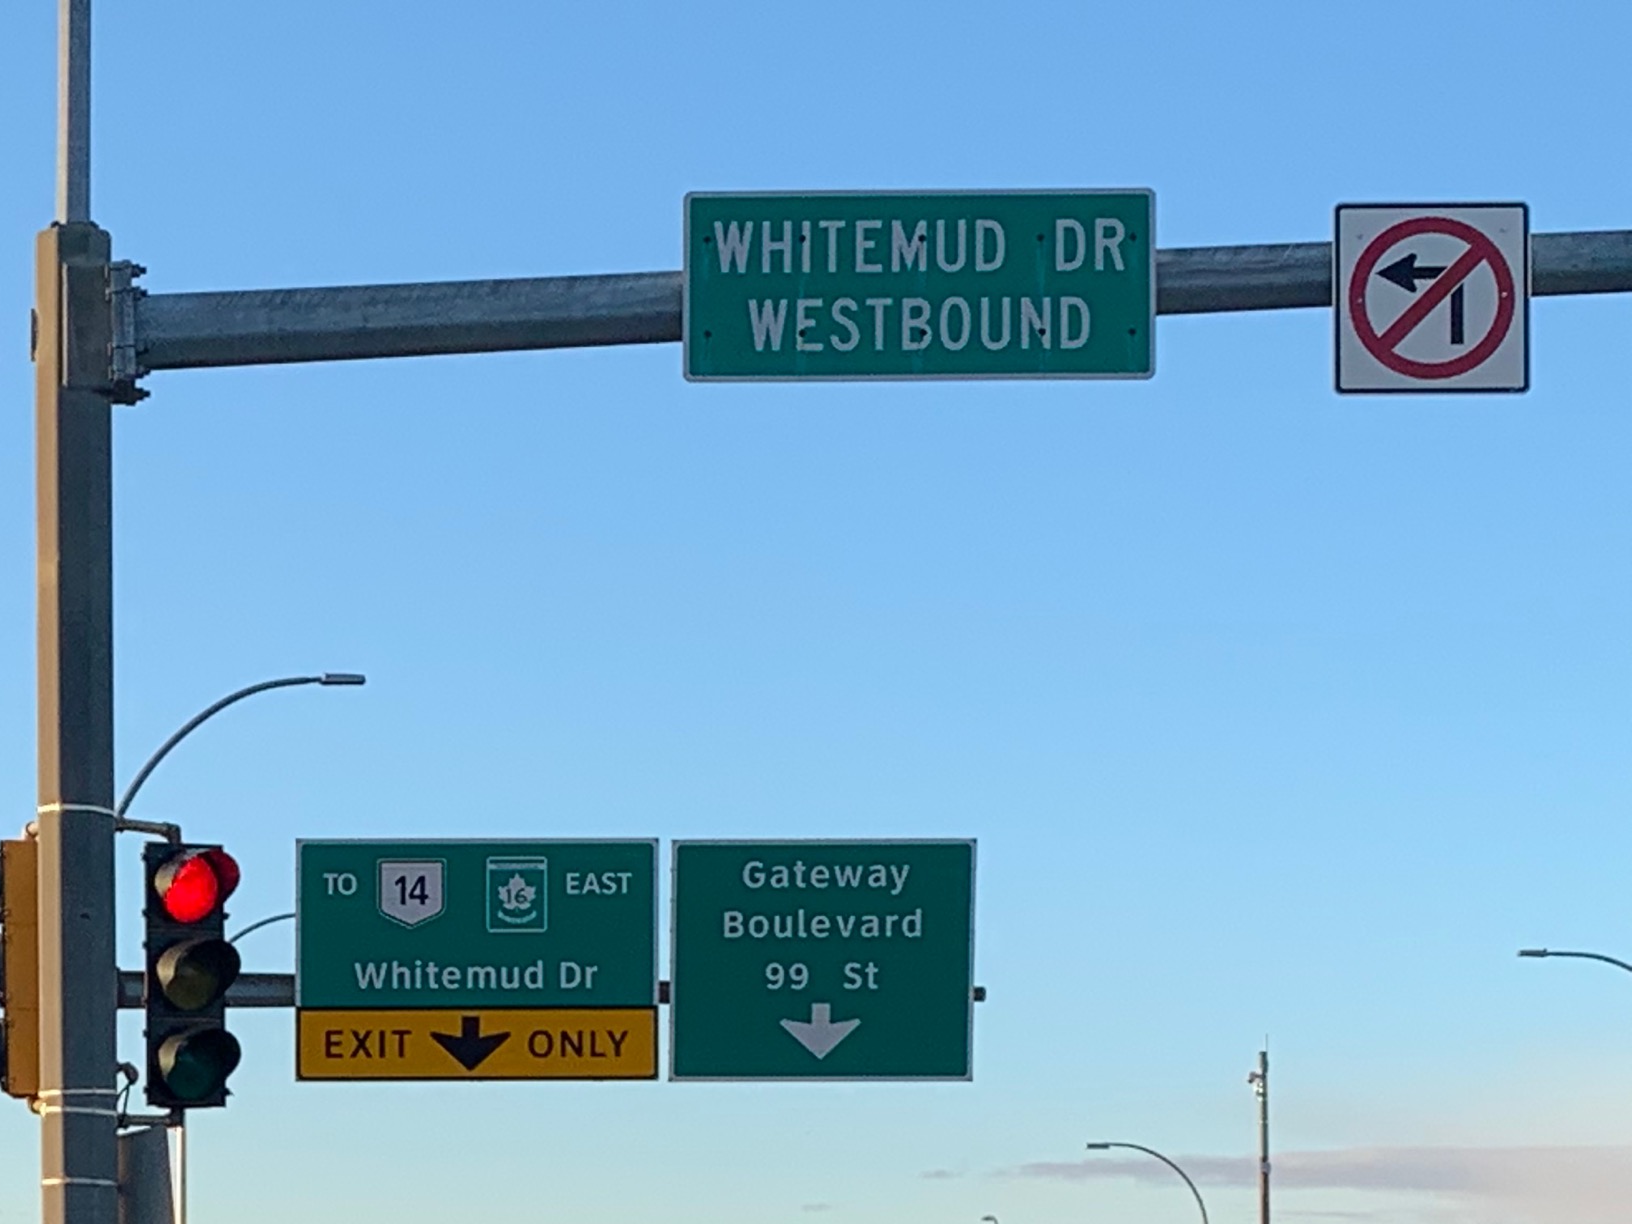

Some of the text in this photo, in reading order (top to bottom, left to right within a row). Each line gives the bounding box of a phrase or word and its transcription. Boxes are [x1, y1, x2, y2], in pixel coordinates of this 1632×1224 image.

[714, 218, 1126, 273] WHITEMUD DR
[748, 296, 1091, 351] WESTBOUND
[323, 872, 633, 906] TO 14 16 EAST
[742, 860, 910, 896] Gateway
[723, 908, 923, 938] Boulevard
[354, 959, 599, 990] Whitemud Dr
[765, 961, 880, 990] 99 St
[324, 1029, 630, 1059] EXIT ONLY
